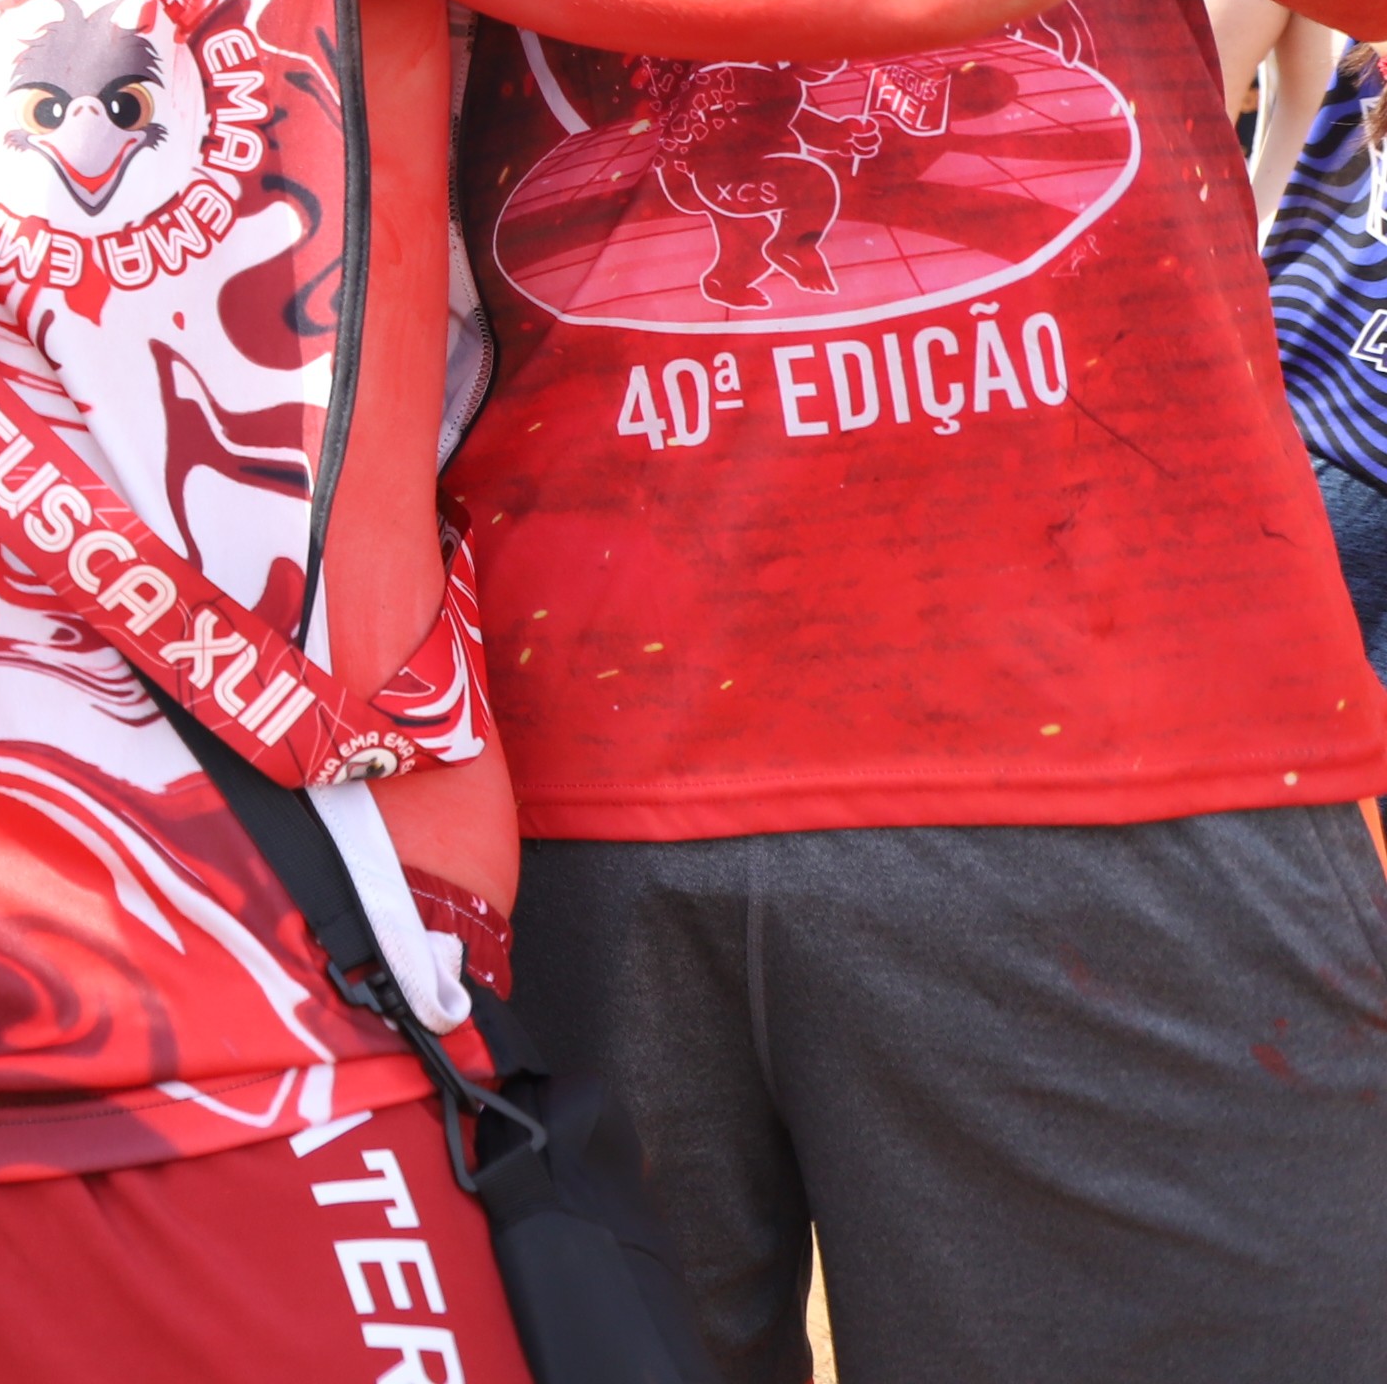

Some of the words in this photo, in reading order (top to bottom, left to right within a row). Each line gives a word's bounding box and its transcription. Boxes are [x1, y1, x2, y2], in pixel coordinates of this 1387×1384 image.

[203, 27, 271, 175] EMA
[875, 84, 932, 130] FIEL
[104, 179, 234, 289] EMA
[772, 300, 1069, 436] EDIÇÃO
[159, 607, 316, 748] XLII
[338, 730, 380, 758] EMA
